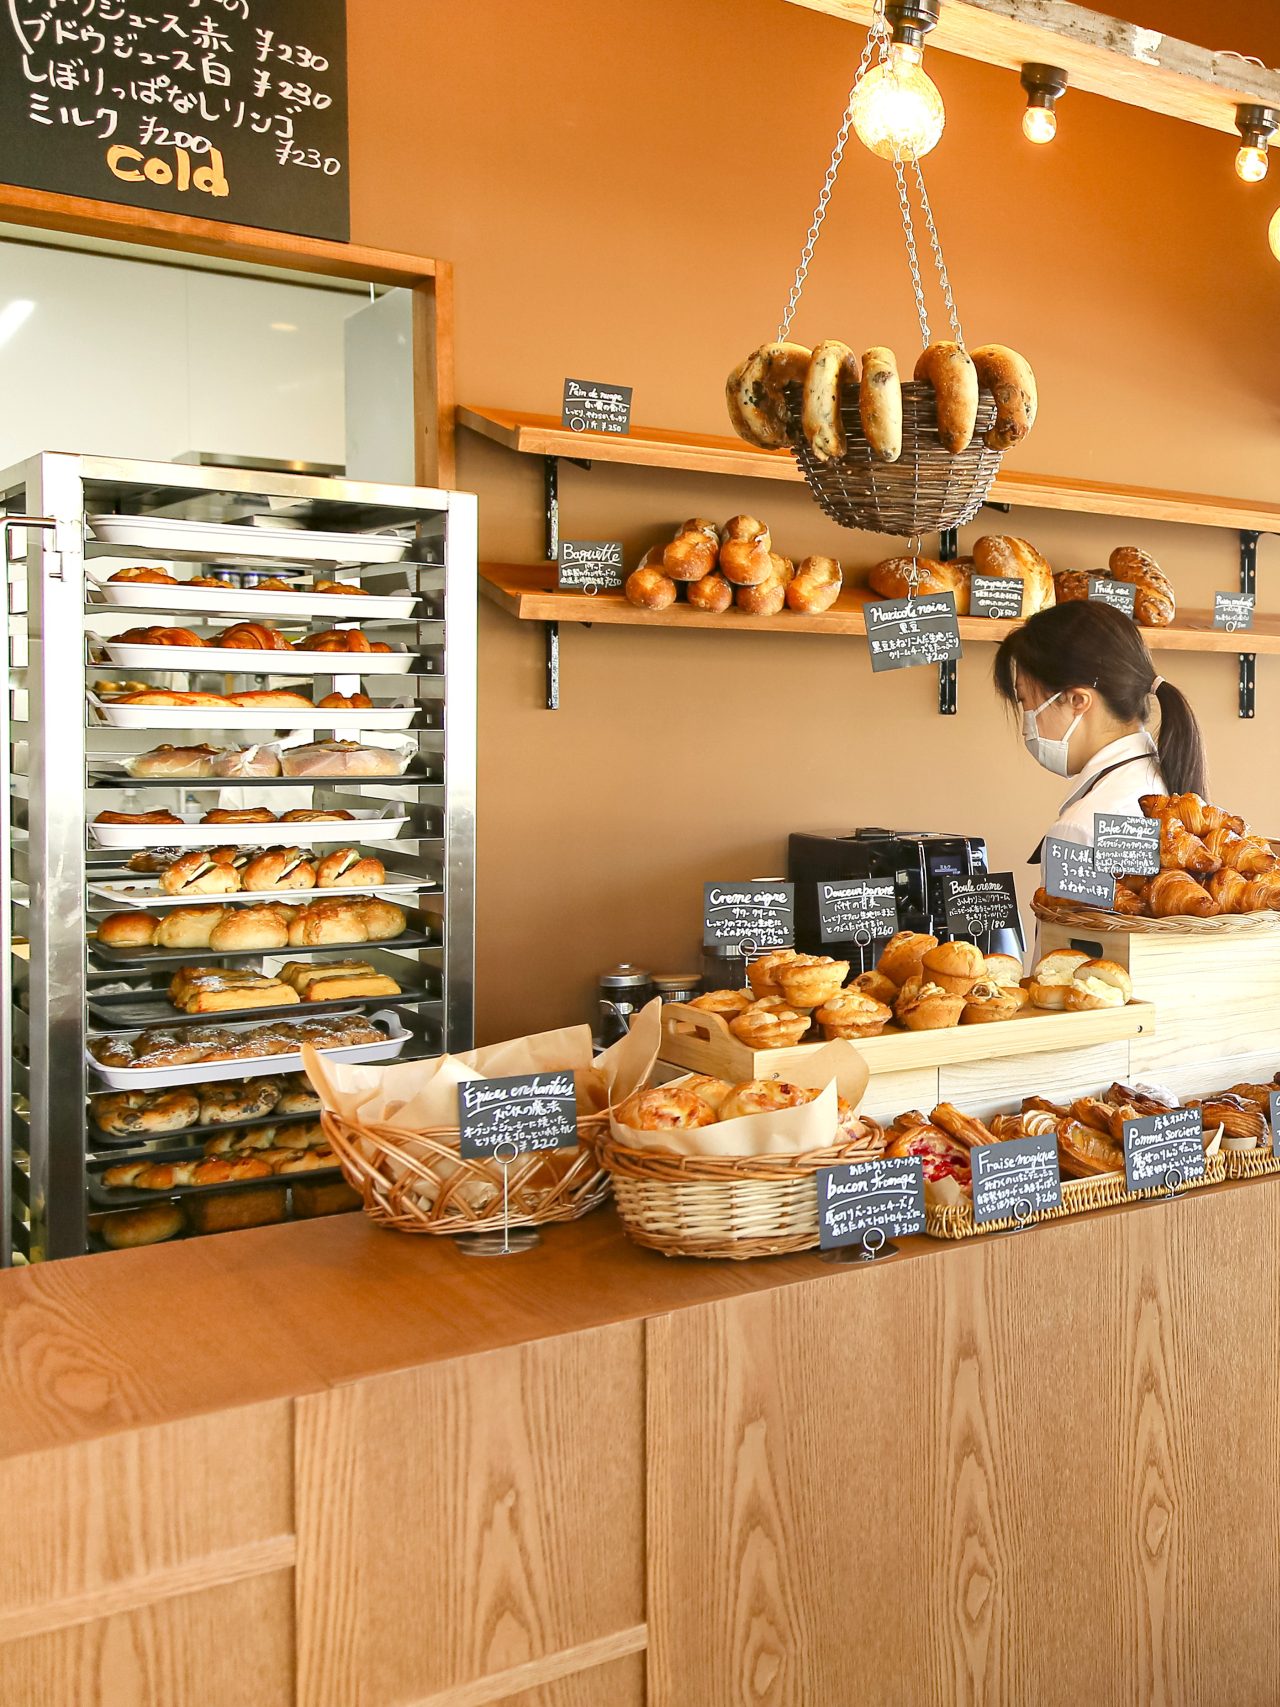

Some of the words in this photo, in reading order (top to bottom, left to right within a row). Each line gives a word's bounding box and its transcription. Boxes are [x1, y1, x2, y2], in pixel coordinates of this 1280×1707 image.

[29, 93, 118, 139] ミルク
[563, 543, 621, 562] Baguette
[870, 601, 916, 623] Haricots
[871, 926, 894, 939] ¥260
[1128, 1127, 1164, 1150] Pomme
[978, 1149, 1016, 1175] Fraise
[826, 1173, 869, 1200] bacon
[1035, 1190, 1058, 1207] ¥260
[893, 1222, 920, 1236] ¥320
